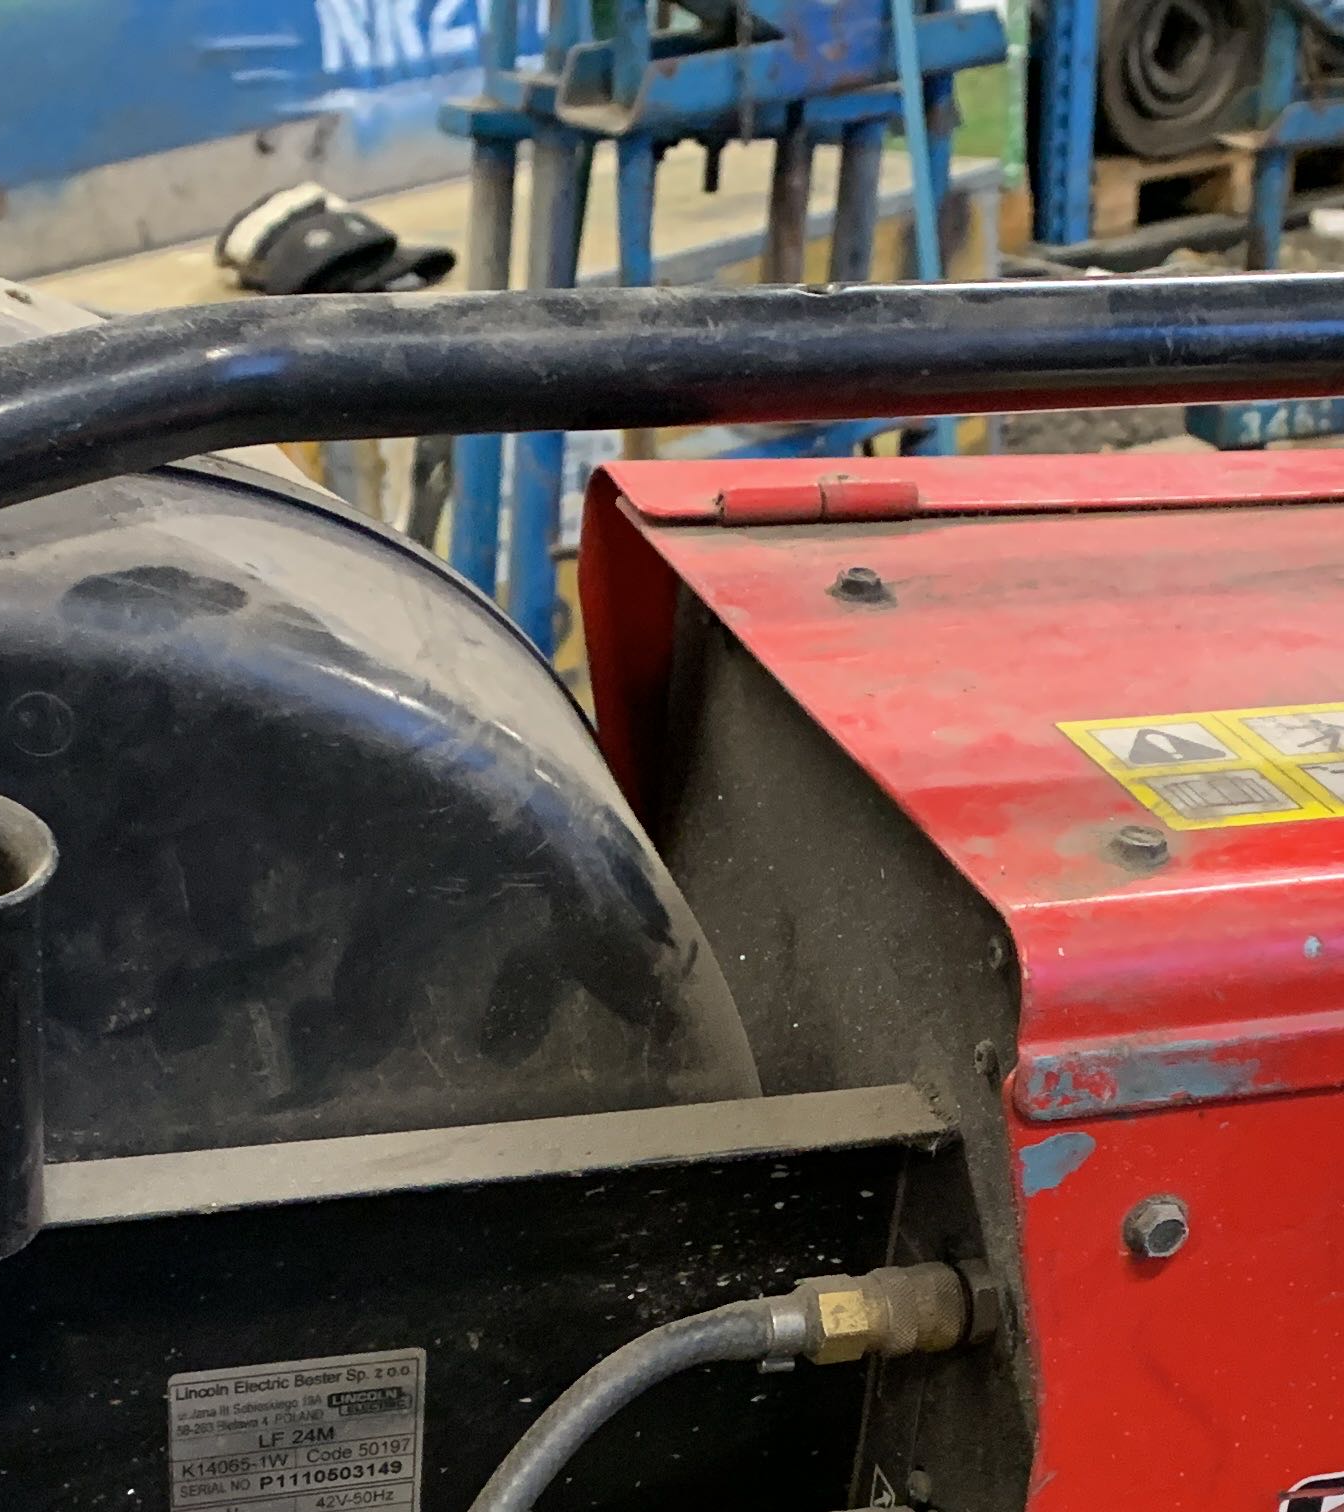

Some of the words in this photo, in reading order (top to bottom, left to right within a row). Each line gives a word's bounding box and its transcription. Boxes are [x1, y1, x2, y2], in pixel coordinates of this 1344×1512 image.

[176, 1384, 228, 1400] Lincoln
[235, 1378, 290, 1394] Electric
[294, 1371, 342, 1387] Bester
[331, 1387, 397, 1405] LINCOLN
[259, 1431, 285, 1448] LF
[292, 1426, 335, 1445] 24M
[307, 1446, 353, 1462] Code
[358, 1438, 411, 1457] 50197
[180, 1482, 226, 1498] SERIAL
[230, 1478, 251, 1492] NO
[260, 1460, 403, 1490] P1110503149
